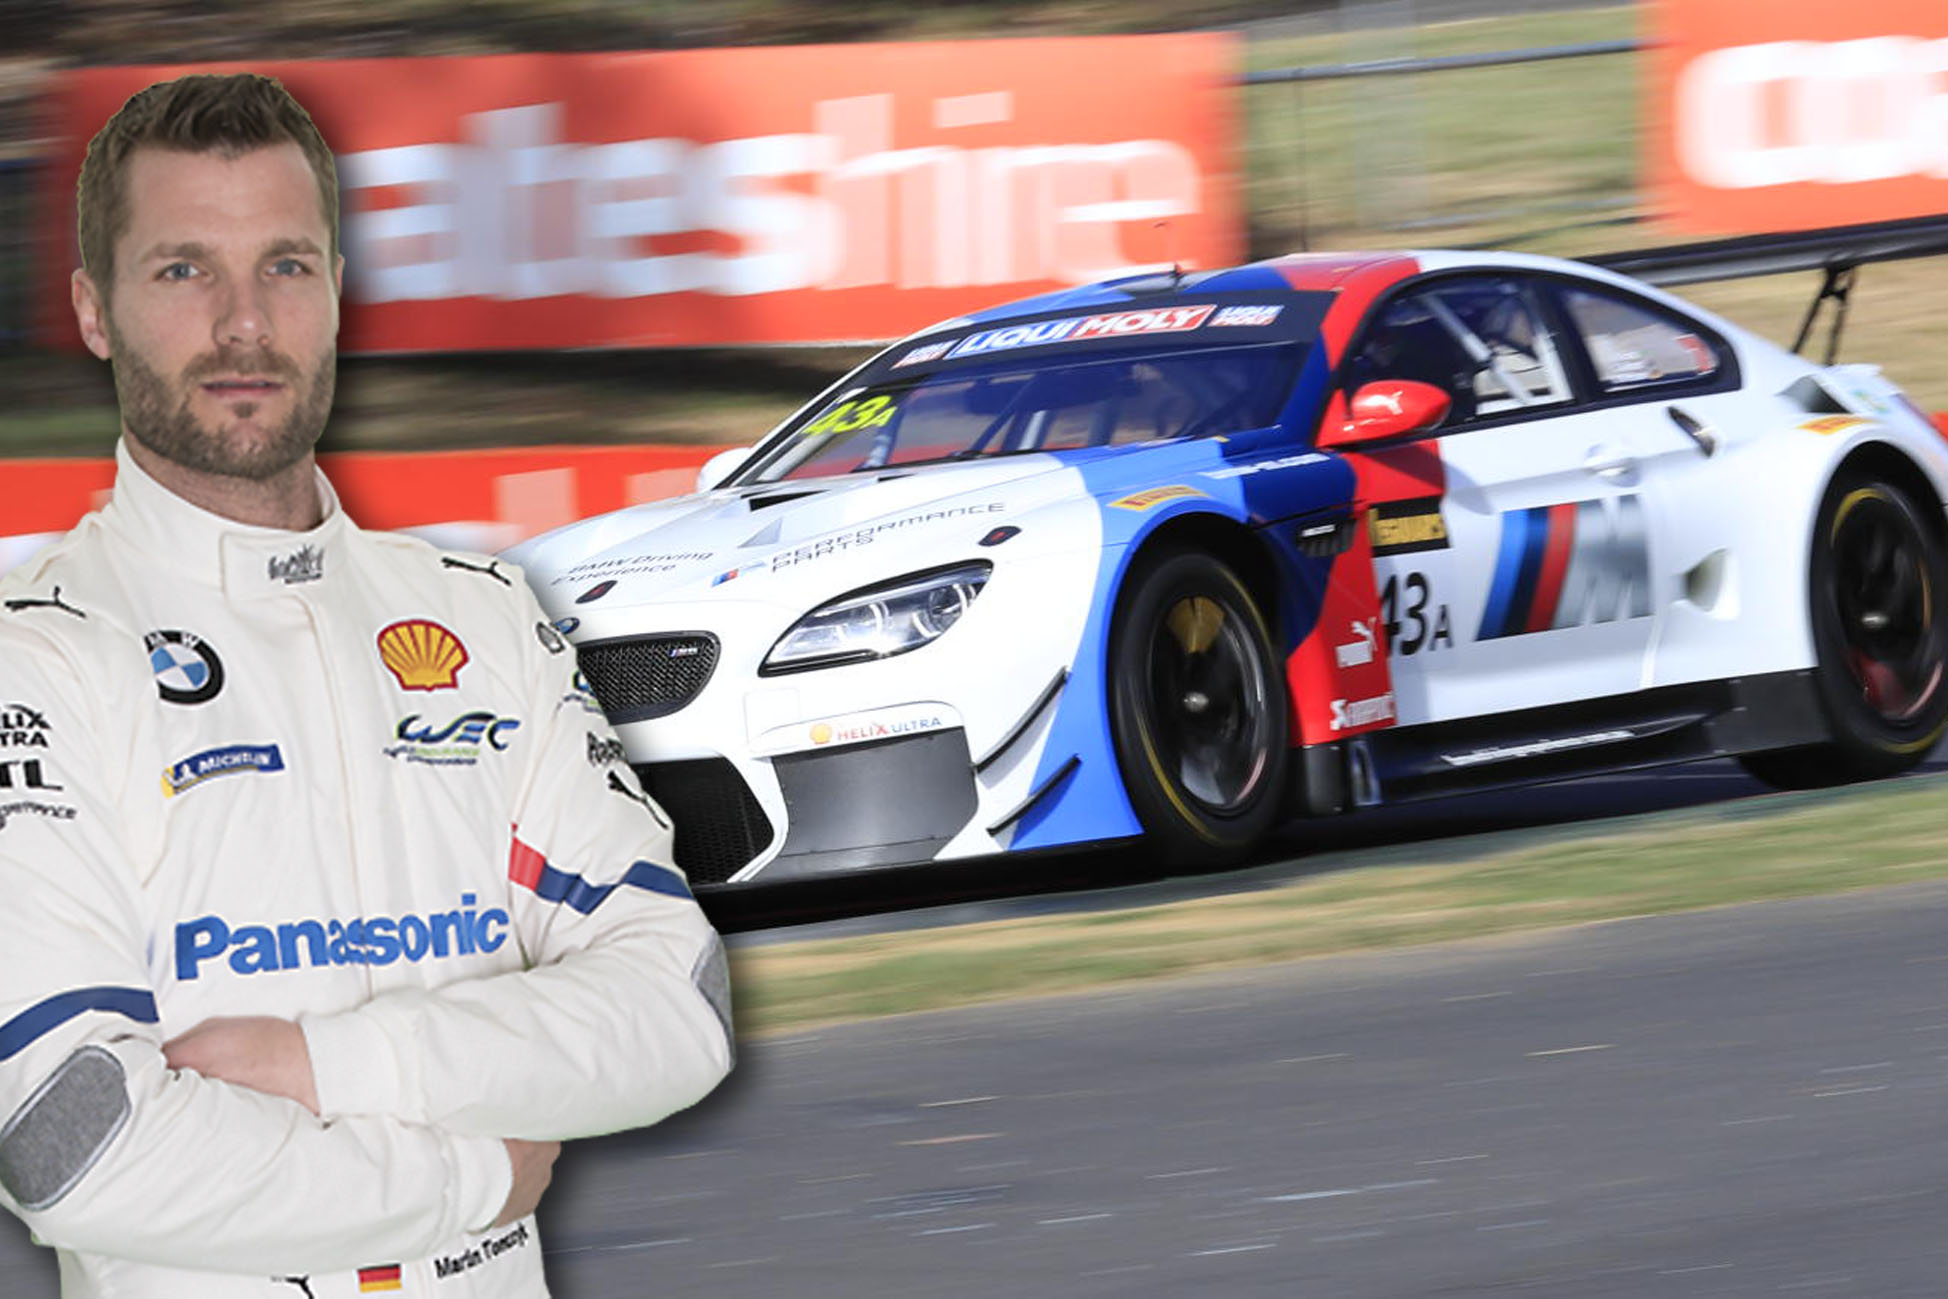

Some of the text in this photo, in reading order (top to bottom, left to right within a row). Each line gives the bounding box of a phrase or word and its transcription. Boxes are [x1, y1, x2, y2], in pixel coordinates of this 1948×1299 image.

[957, 304, 1212, 353] LIQUI MOLY
[772, 502, 1006, 563] PERFORMANCE
[772, 534, 875, 573] PARTS
[631, 551, 715, 566] Driving
[836, 716, 943, 742] HELIX ULTRA
[174, 892, 511, 982] Panasonic
